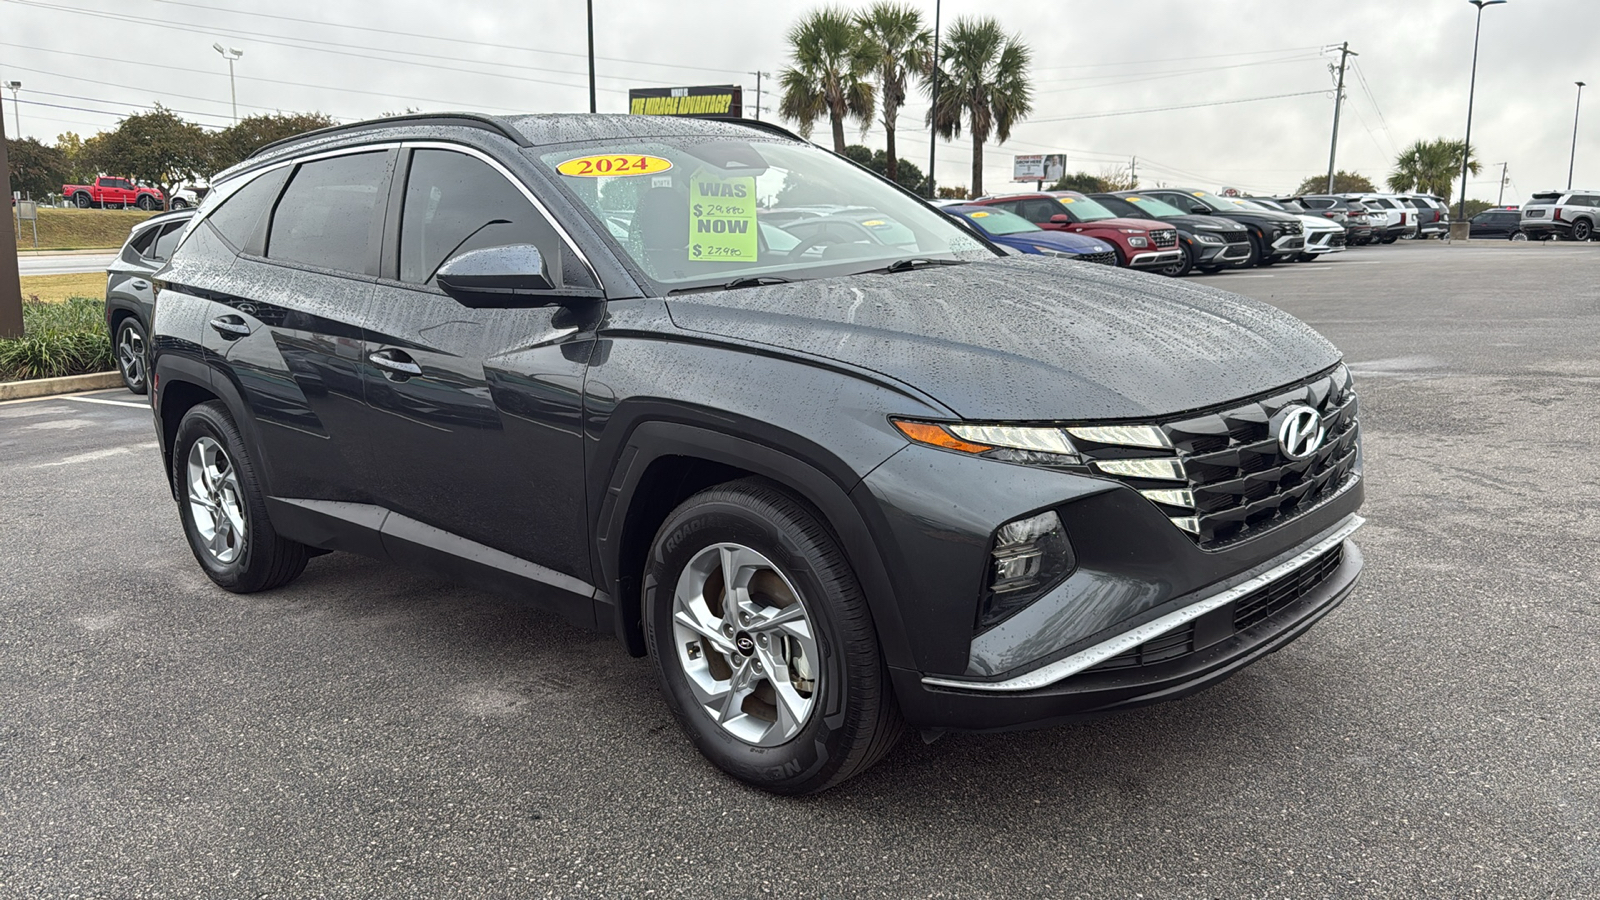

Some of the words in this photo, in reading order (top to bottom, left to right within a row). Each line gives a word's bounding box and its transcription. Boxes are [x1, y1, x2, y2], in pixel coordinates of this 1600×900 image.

[630, 98, 646, 115] THE
[644, 96, 679, 115] MIRACLE
[677, 94, 732, 115] ADVANTAGE?
[577, 157, 648, 175] 2024
[698, 182, 747, 198] WAS
[697, 219, 748, 234] NOW
